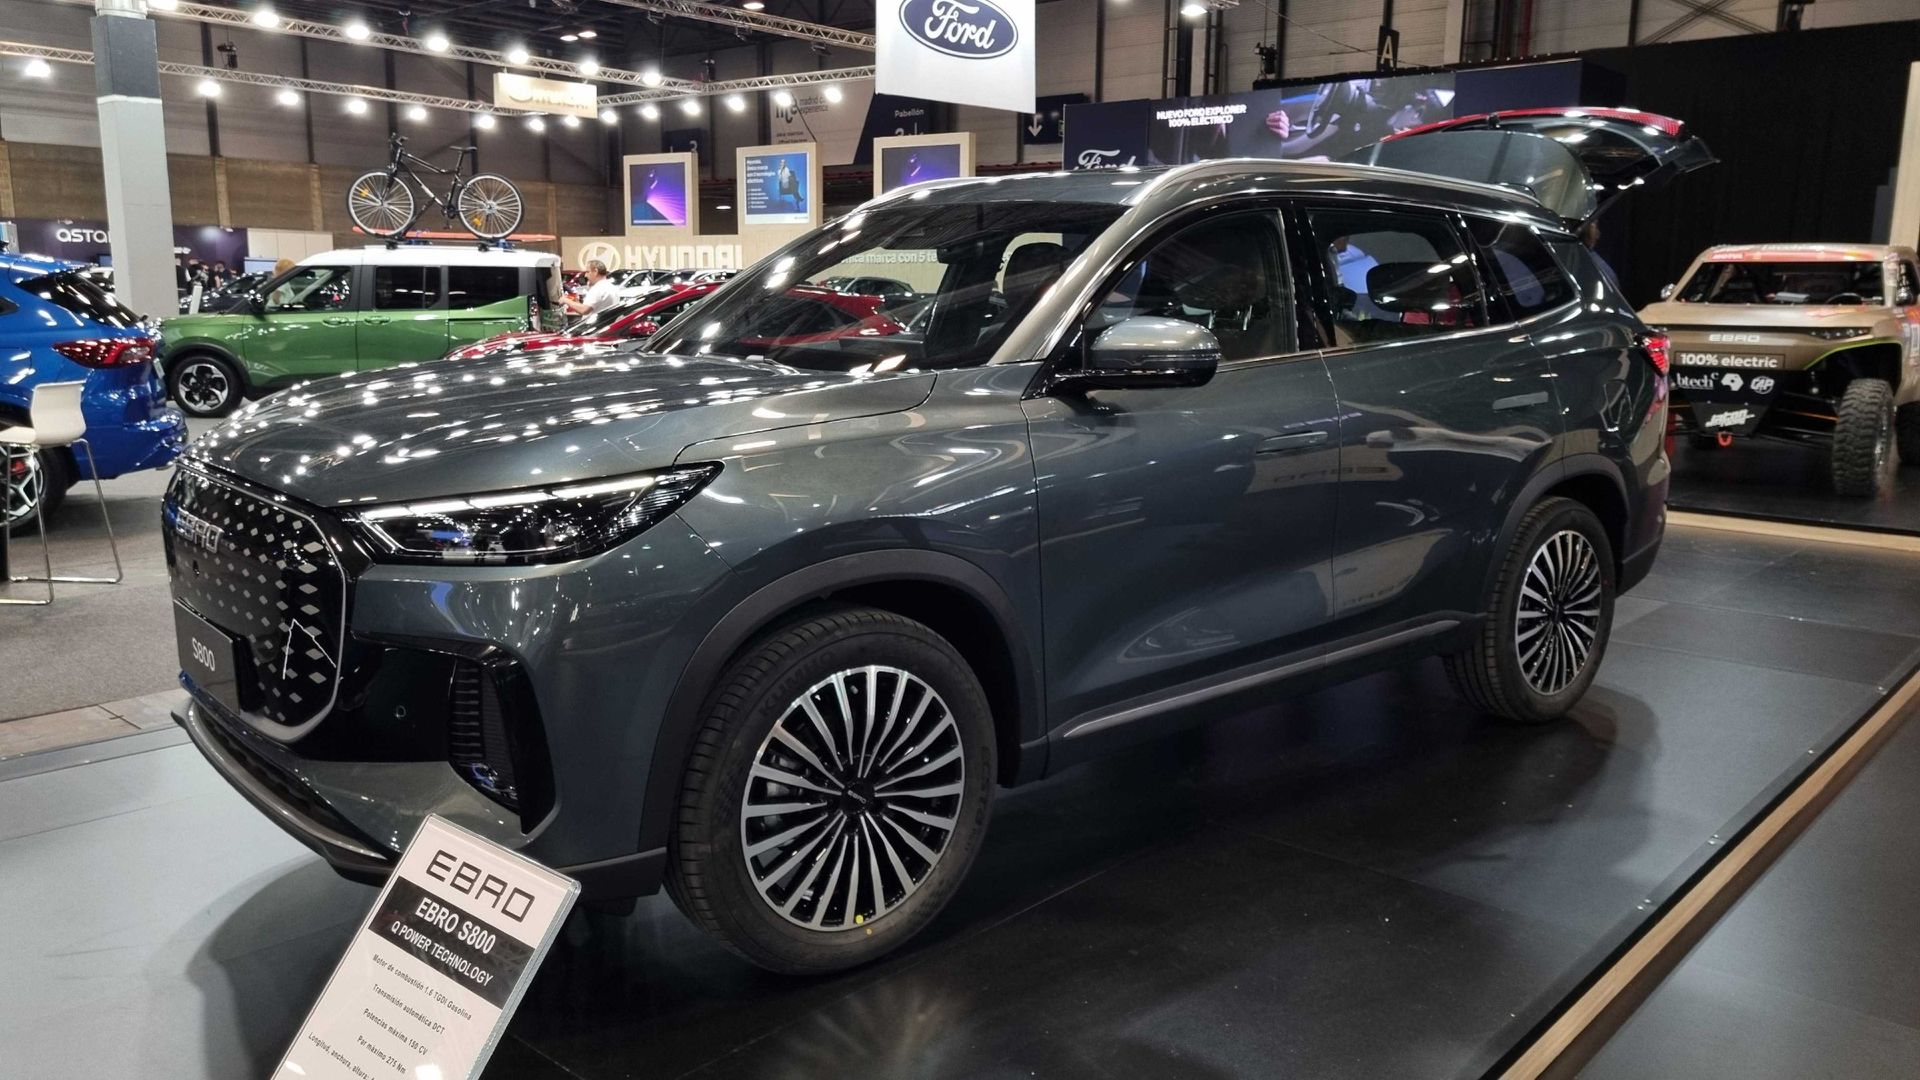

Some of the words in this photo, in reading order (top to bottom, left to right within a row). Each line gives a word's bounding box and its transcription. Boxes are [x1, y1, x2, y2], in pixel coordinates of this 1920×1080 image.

[924, 0, 997, 49] Ford
[1380, 35, 1394, 68] A
[1156, 109, 1184, 120] NUEVO
[1184, 107, 1205, 117] FORD
[1205, 104, 1247, 116] EXPLORER
[1168, 118, 1191, 128] 100%
[624, 244, 743, 269] HYUNDAI
[866, 254, 896, 264] marca
[898, 253, 917, 263] con
[919, 252, 926, 263] 5
[1709, 333, 1760, 342] EBRO
[1680, 353, 1718, 366] 100%
[1721, 355, 1778, 368] electric
[176, 506, 223, 553] EBRO
[192, 637, 216, 671] S800
[426, 849, 535, 923] EBRO
[415, 897, 459, 933] EBRO
[458, 921, 496, 954] S800
[391, 921, 401, 935] Q
[398, 924, 432, 952] POWER
[430, 942, 494, 987] TECHNOLOGY
[372, 953, 387, 969] Motor
[387, 963, 394, 972] de
[394, 967, 424, 991] combustión
[447, 1000, 472, 1021] Gasolina
[373, 983, 402, 1007] Transmisión
[402, 1004, 432, 1027] automática
[432, 1022, 445, 1035] DCT
[363, 1008, 388, 1030] Potencias
[388, 1025, 408, 1044] máxima
[418, 1044, 428, 1056] CV
[357, 1035, 367, 1047] Par
[367, 1040, 386, 1061] máximo
[386, 1056, 398, 1068] 275
[398, 1063, 406, 1075] Nm
